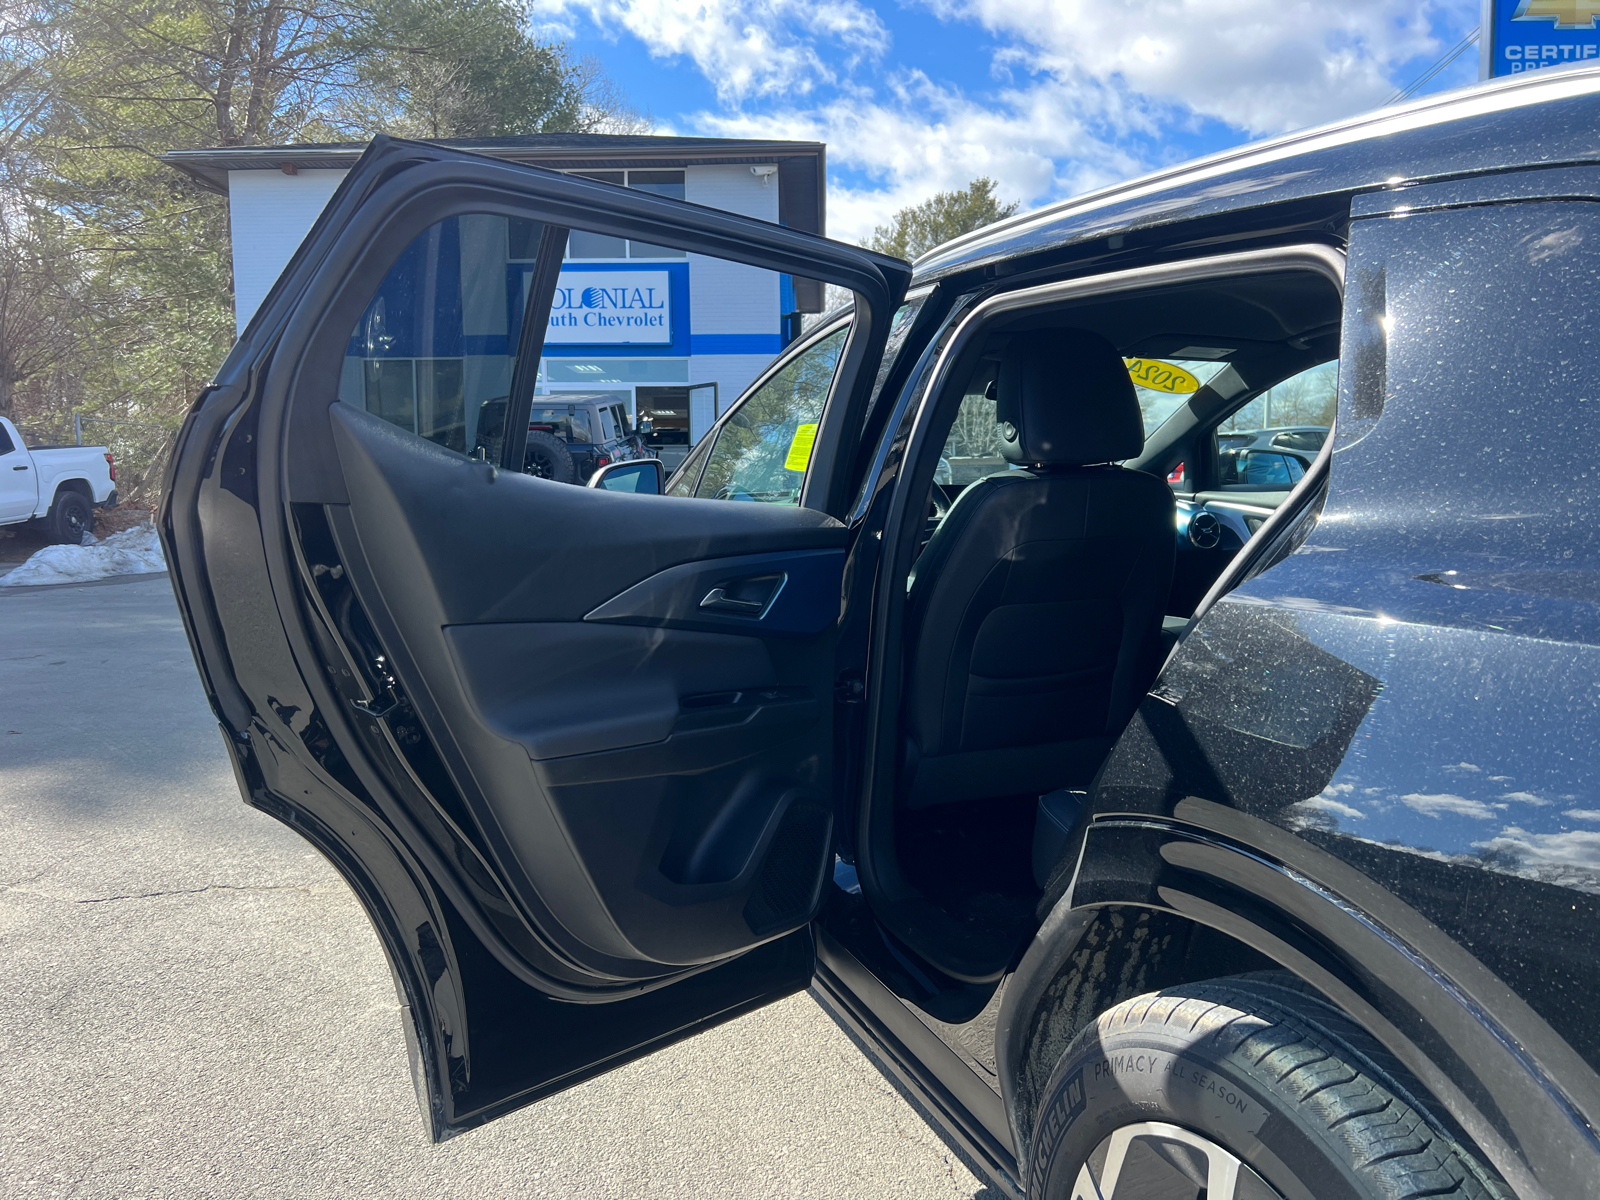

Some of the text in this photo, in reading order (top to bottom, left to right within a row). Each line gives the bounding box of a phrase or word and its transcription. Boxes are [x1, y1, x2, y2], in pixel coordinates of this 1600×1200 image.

[1505, 45, 1600, 59] CERTIF
[551, 287, 664, 310] OLONIAL
[584, 312, 664, 327] Chevrolet
[1095, 1055, 1157, 1080] PRIMACY
[1164, 1061, 1185, 1078] ALL
[1191, 1072, 1247, 1113] SEASON
